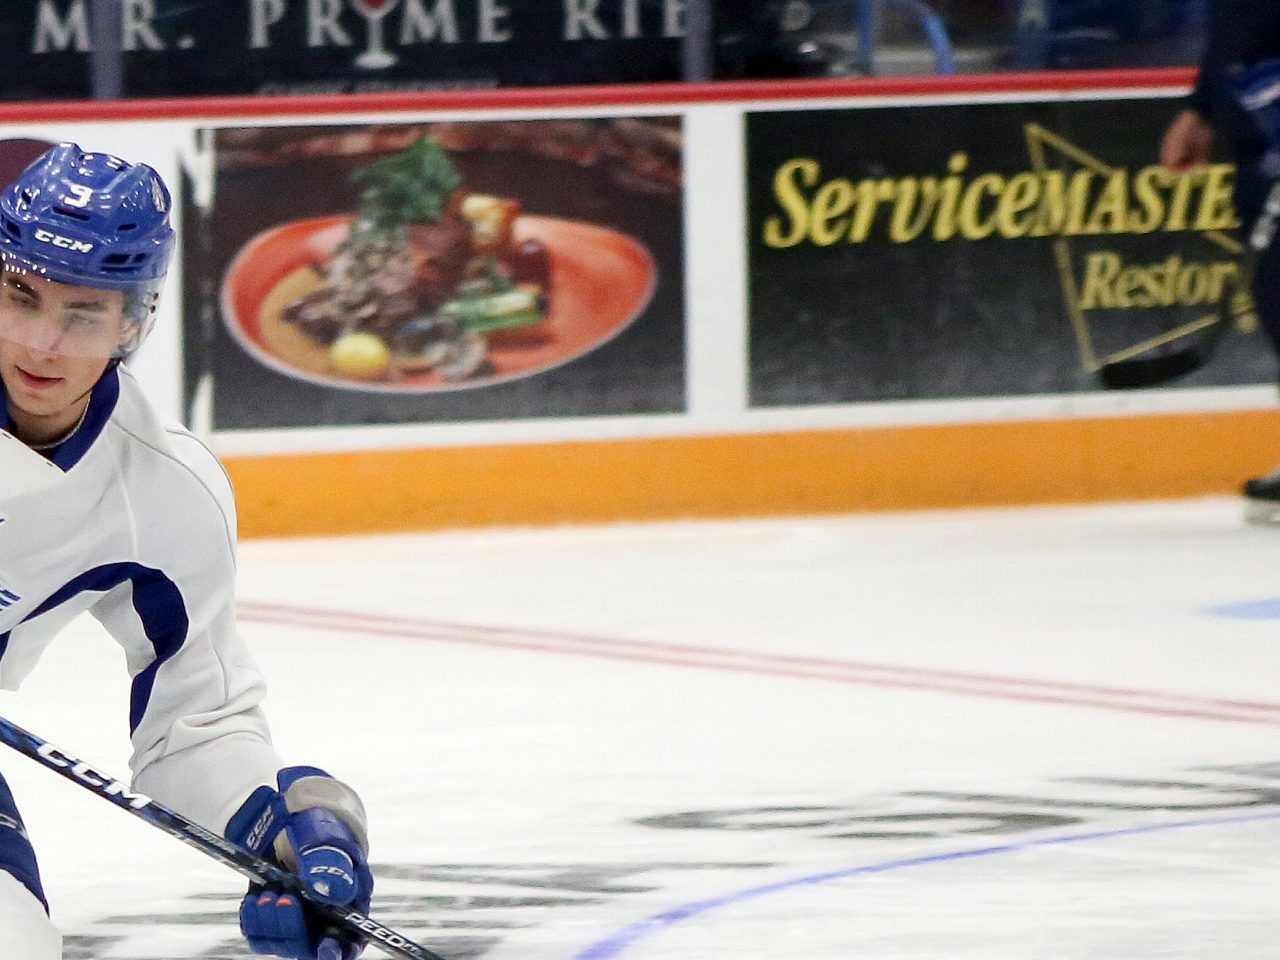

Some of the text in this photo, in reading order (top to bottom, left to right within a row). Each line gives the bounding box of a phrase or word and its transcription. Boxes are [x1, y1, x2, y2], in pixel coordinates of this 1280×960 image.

[763, 151, 1242, 249] ServiceMASTE
[34, 228, 94, 254] CCM
[1081, 251, 1241, 311] Restor
[36, 743, 154, 810] CCM
[344, 911, 407, 951] PEED
